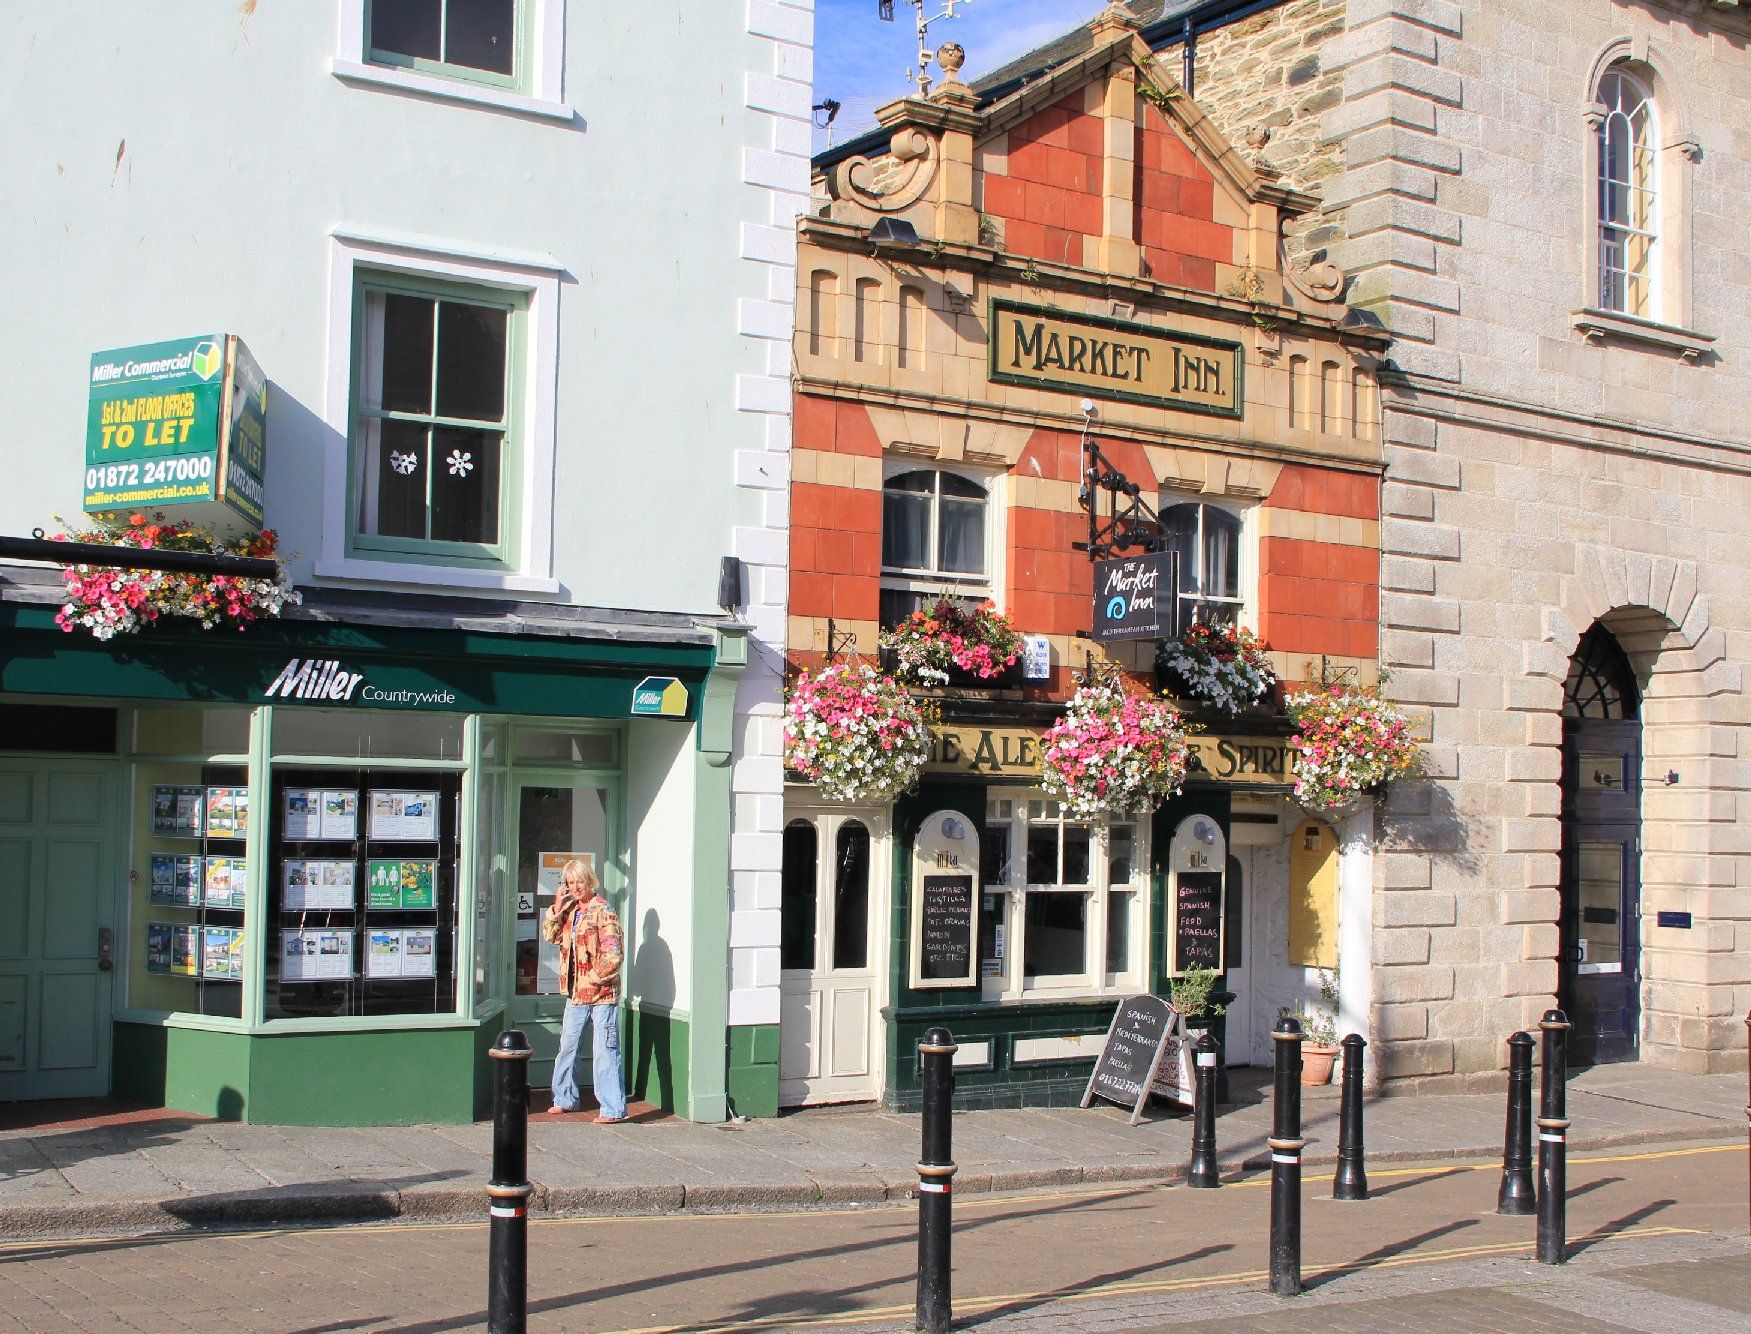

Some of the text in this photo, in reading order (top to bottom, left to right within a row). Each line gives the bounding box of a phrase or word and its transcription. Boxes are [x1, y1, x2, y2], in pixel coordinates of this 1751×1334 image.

[1011, 319, 1150, 382] MARKET
[92, 363, 124, 382] Miller
[124, 351, 193, 377] Commercial
[101, 401, 114, 424] 1st
[121, 399, 137, 423] 2nd
[137, 396, 163, 421] FLOOR
[163, 392, 195, 419] OFFICES
[101, 419, 195, 449] TO LET
[86, 456, 211, 489] 01872 247000
[85, 481, 210, 506] miller-commercial.co.uk
[1104, 563, 1158, 595] Market
[1124, 562, 1136, 572] THE
[1129, 588, 1154, 612] Inn
[264, 658, 455, 705] Miller Countrywide
[636, 692, 661, 705] Miller
[968, 730, 1048, 771] ALE
[1216, 739, 1306, 778] SPIRIT
[1179, 902, 1210, 910] SPANISH
[1180, 917, 1202, 925] FOOD
[1185, 928, 1217, 938] PAELLAS
[1127, 1009, 1157, 1026] SPANISH
[1113, 1042, 1132, 1056] TAPAS
